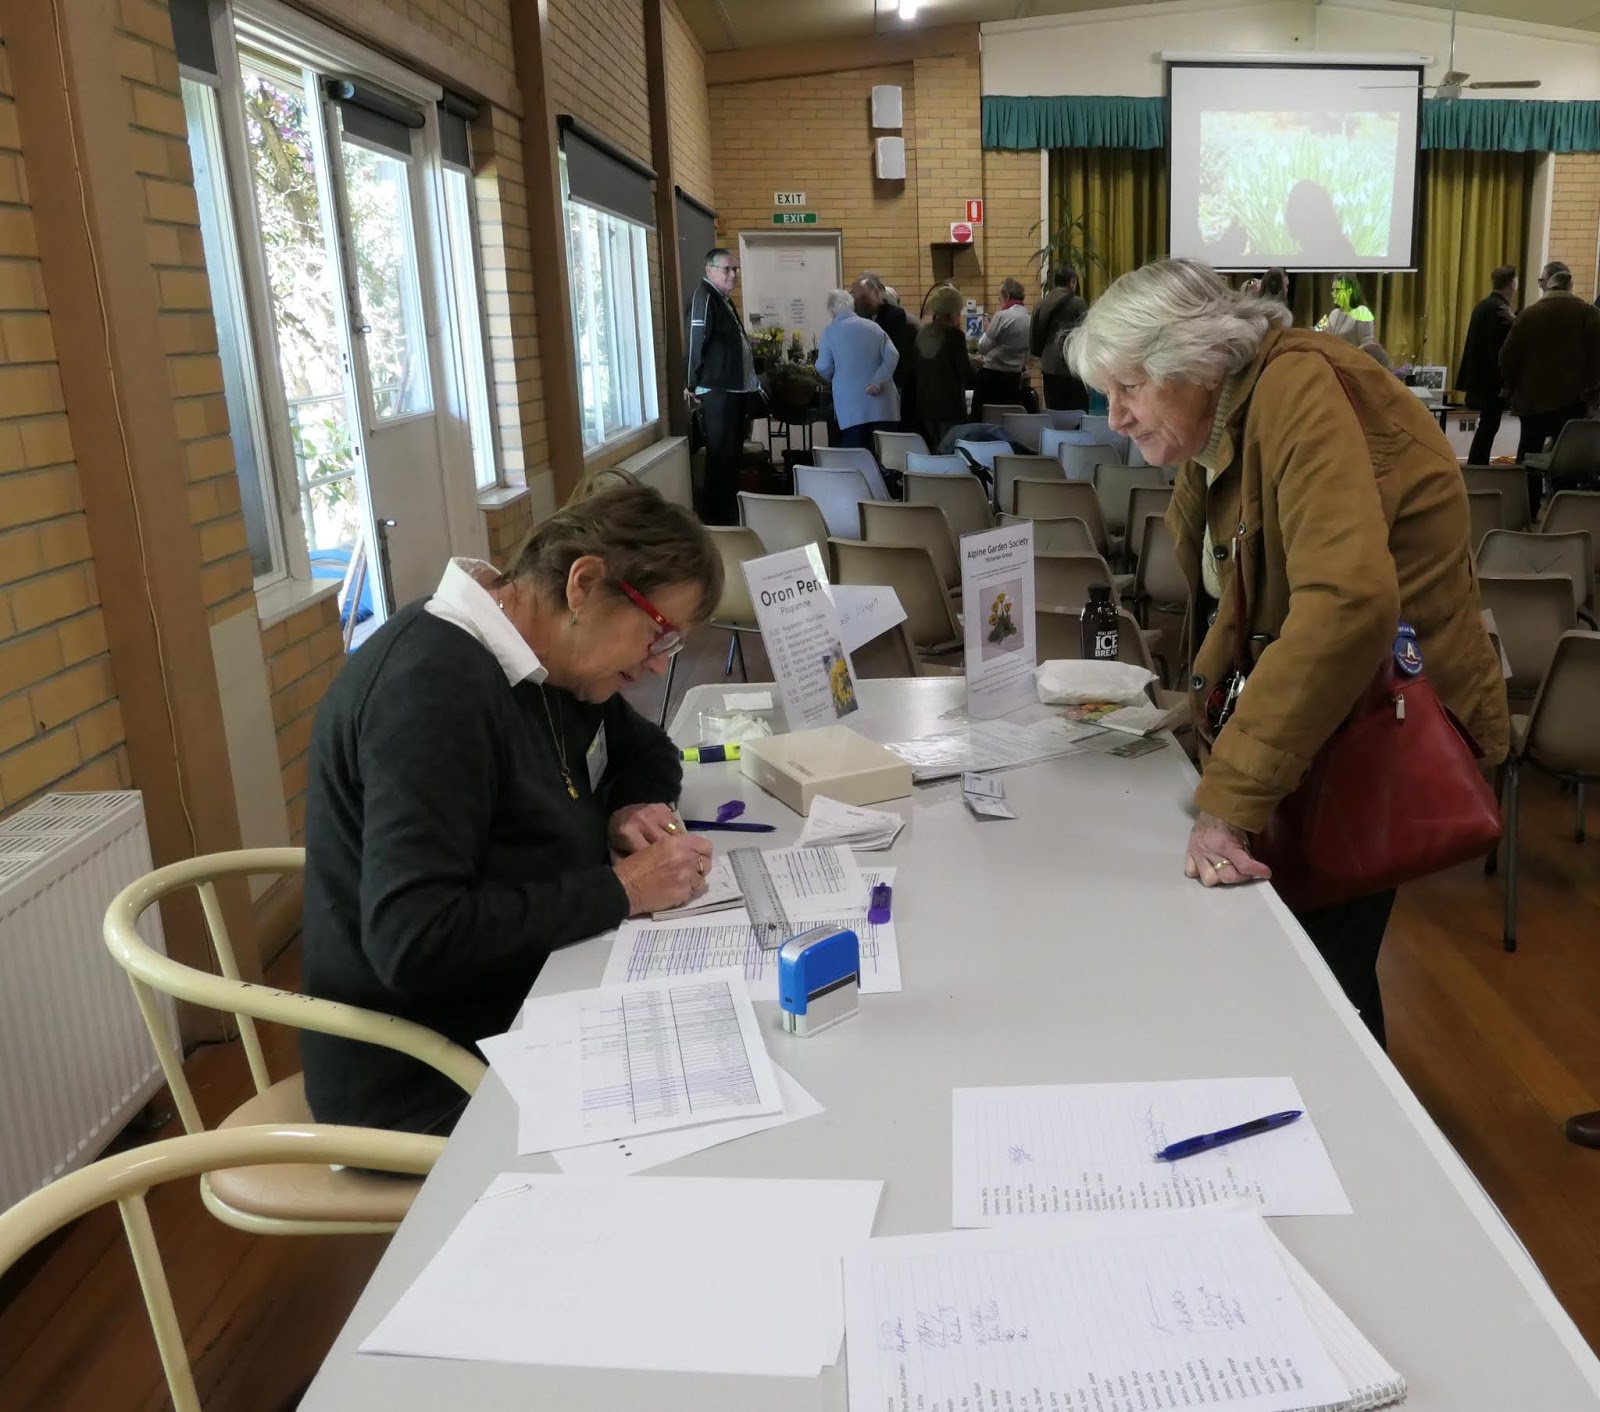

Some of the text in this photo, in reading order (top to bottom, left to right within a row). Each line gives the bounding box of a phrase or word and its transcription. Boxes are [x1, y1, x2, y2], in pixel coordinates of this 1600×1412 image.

[777, 193, 802, 204] EXIT
[783, 214, 806, 223] EXIT
[967, 538, 1029, 559] Alpine Garden Society
[760, 587, 795, 606] Oron
[1095, 634, 1118, 650] ICE
